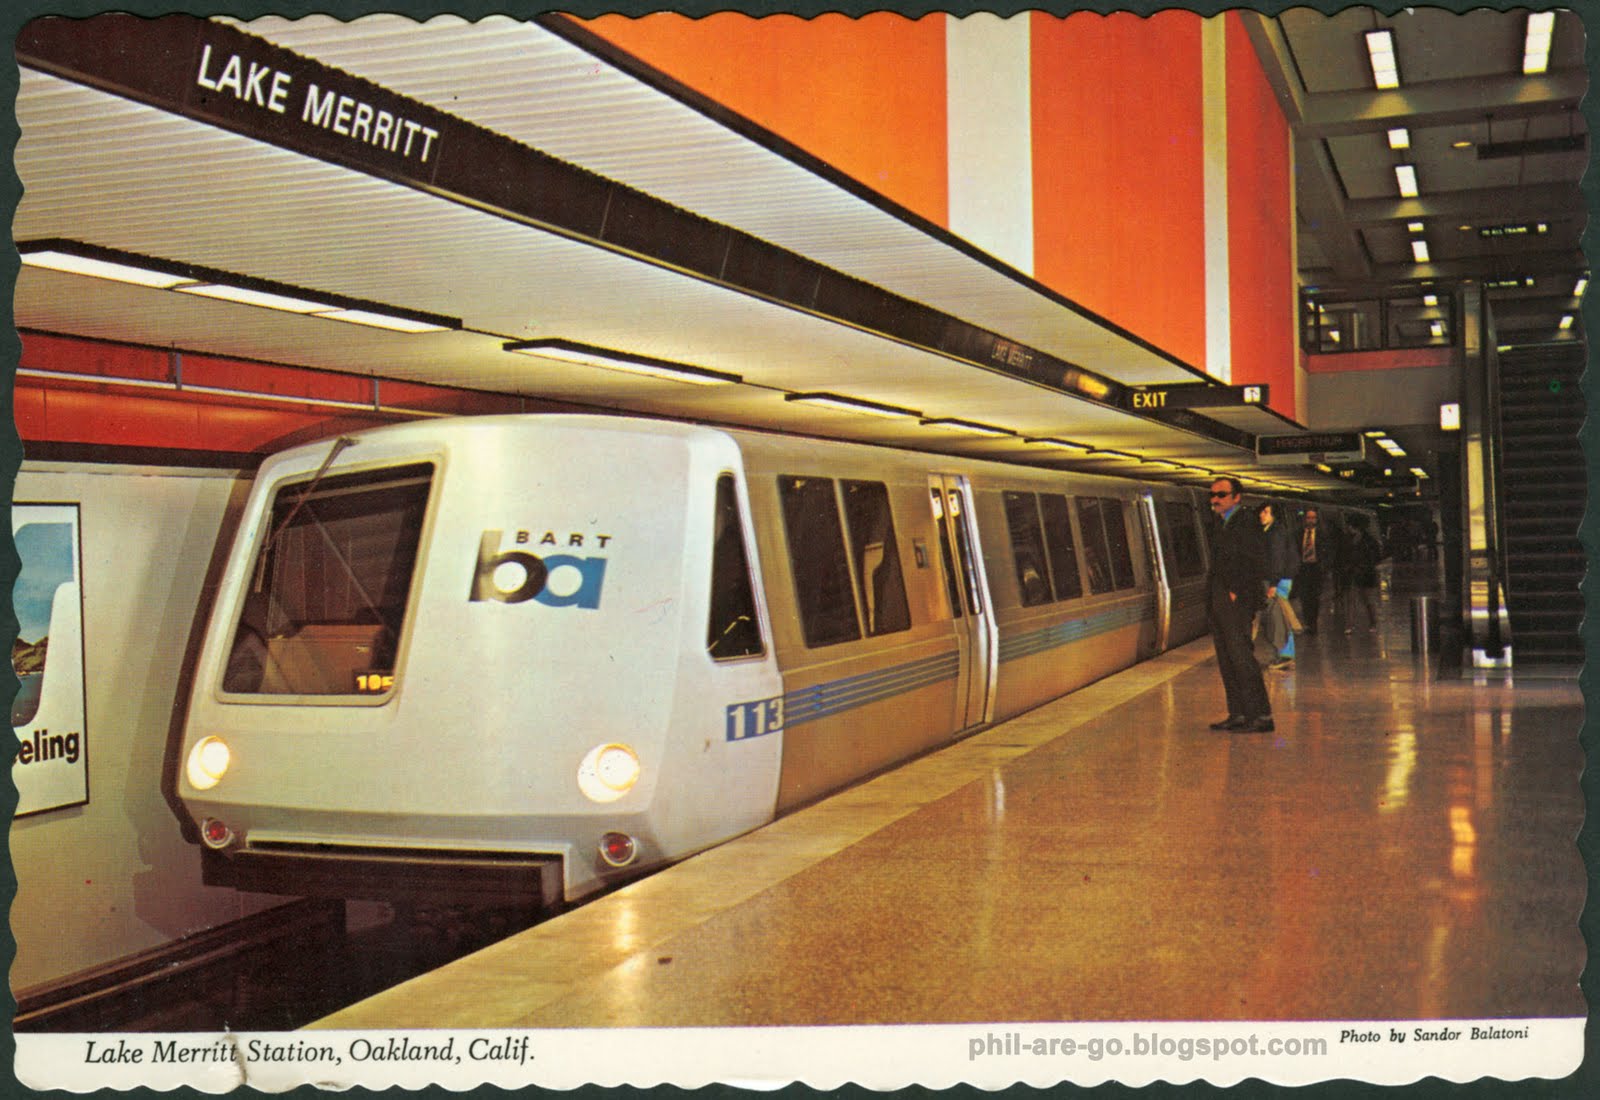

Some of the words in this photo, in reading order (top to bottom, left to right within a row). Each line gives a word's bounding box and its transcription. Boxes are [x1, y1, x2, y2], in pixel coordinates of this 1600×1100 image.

[197, 44, 292, 114] LAKE
[302, 84, 439, 163] MERRITT
[1132, 391, 1167, 408] EXIT
[515, 530, 612, 548] BART
[729, 698, 784, 739] 113
[12, 728, 79, 764] eling
